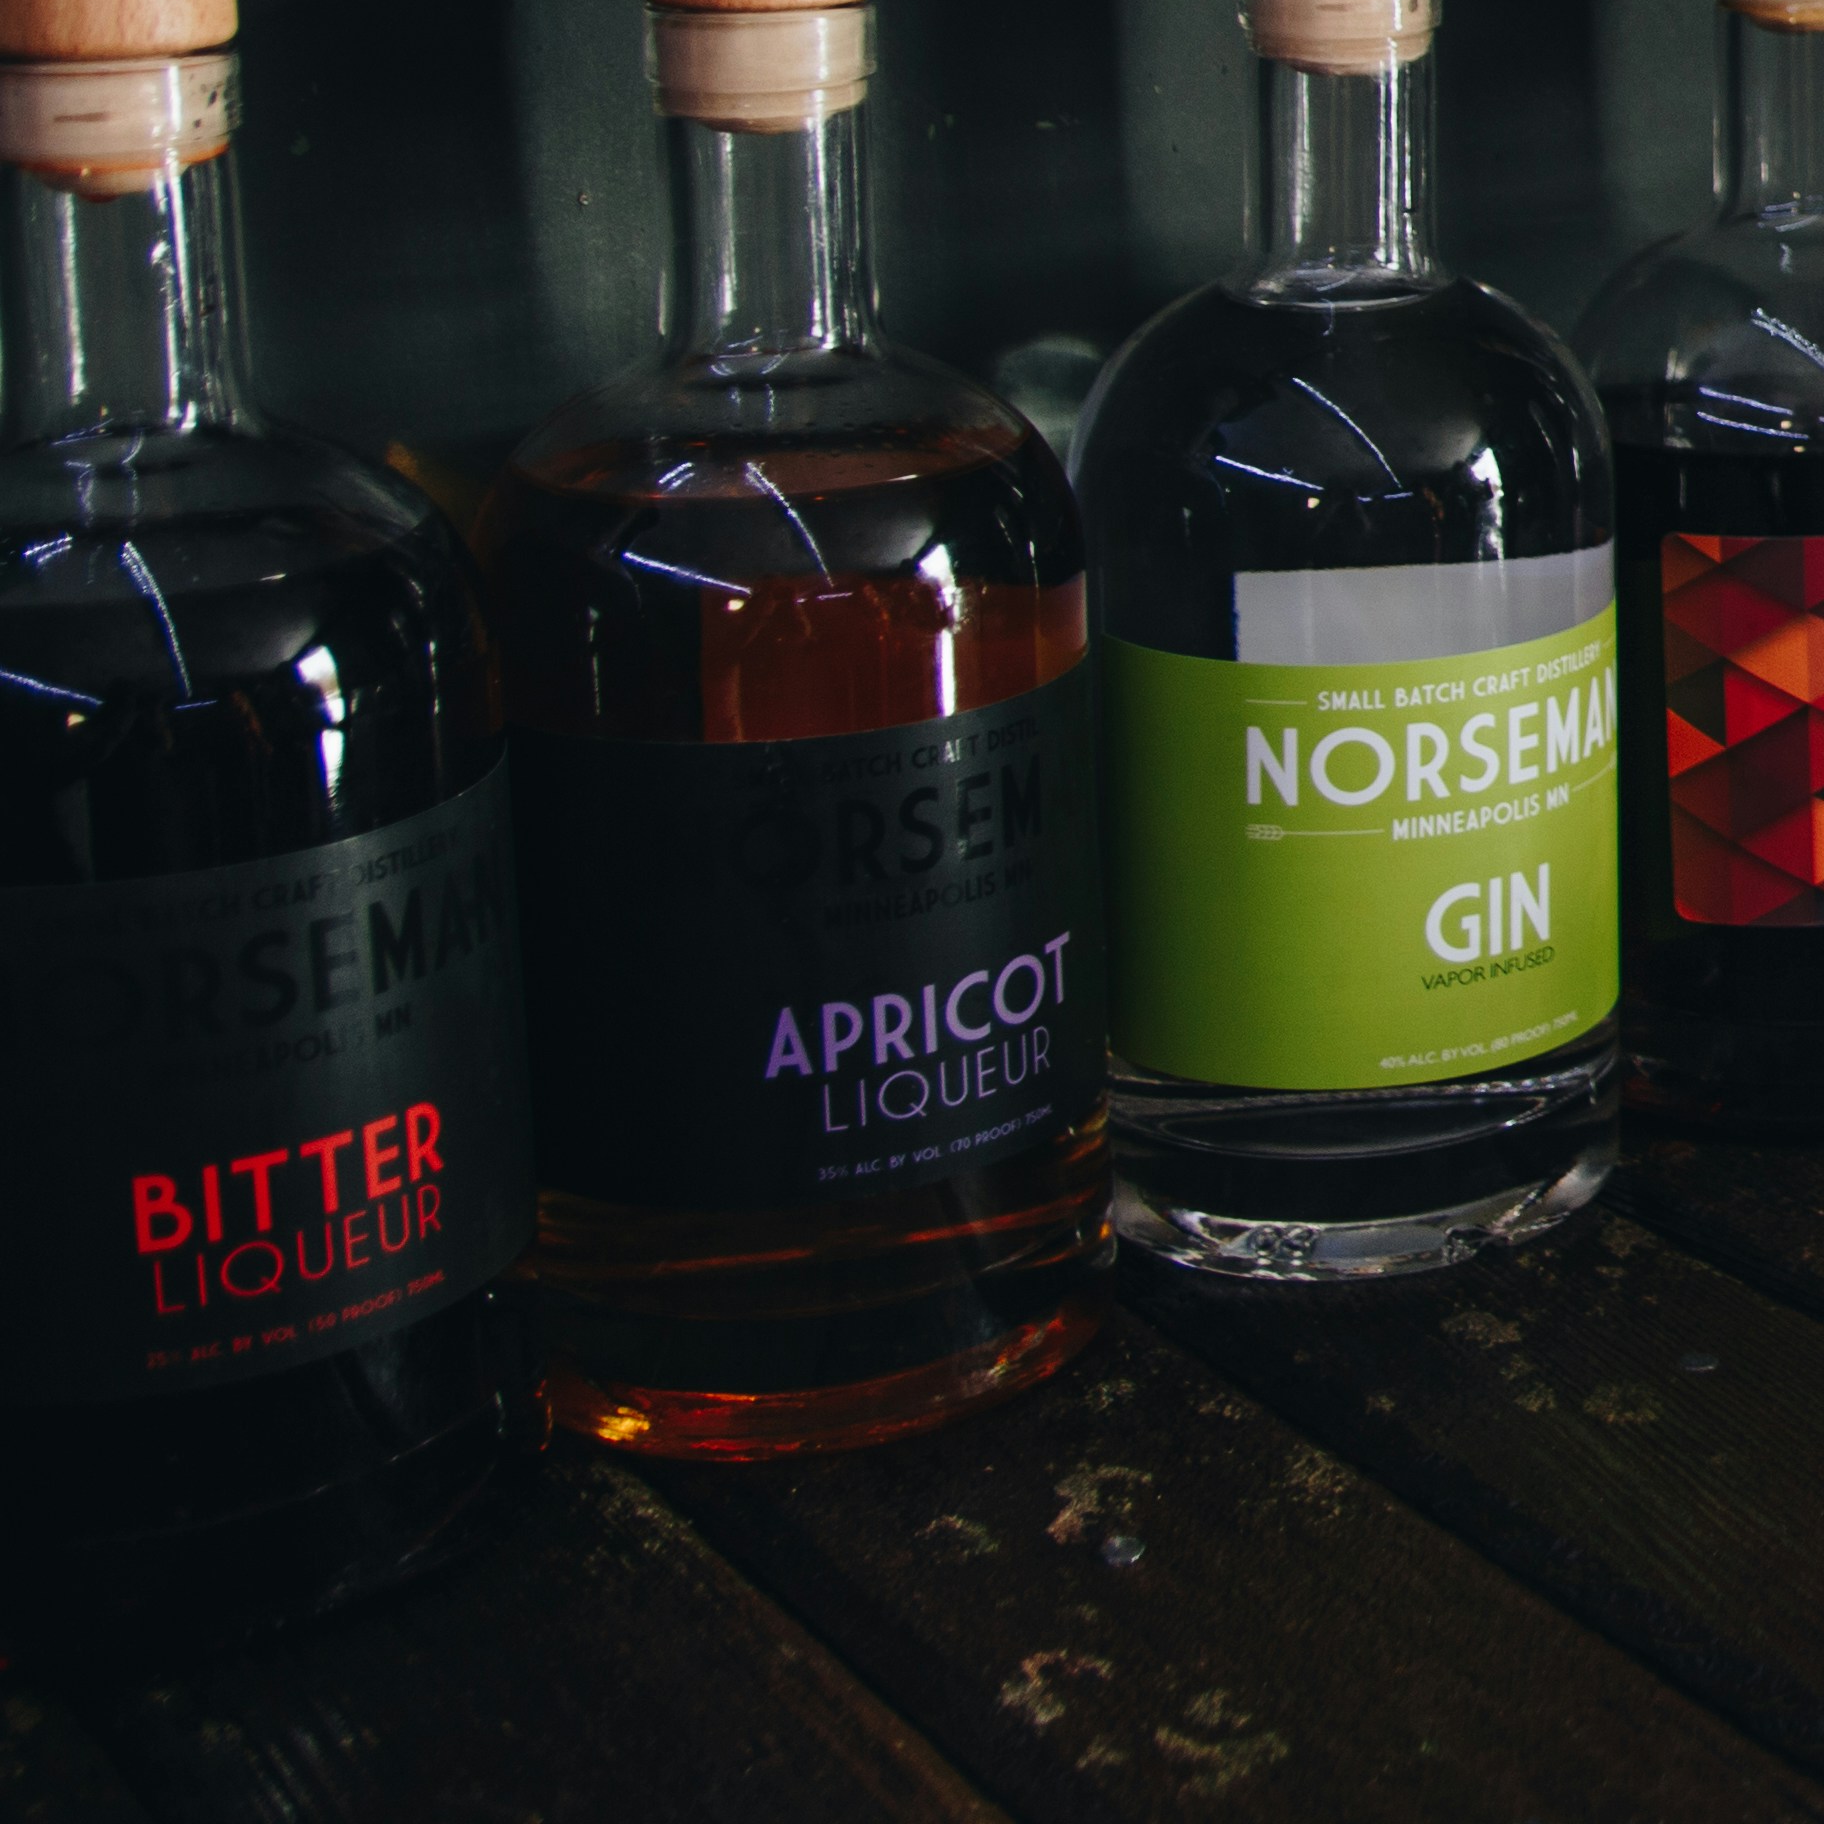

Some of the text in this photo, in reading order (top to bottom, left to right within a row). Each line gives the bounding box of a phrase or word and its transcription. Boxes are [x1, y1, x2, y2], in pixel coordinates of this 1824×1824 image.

[1317, 641, 1601, 711] SMALL BATCH CRAFT DISTILLERY
[1392, 782, 1569, 841] MINNEAPOLIS MN
[824, 871, 997, 930] MINNEAPOLIS
[1425, 862, 1550, 963] GIN
[1421, 945, 1555, 990] VAPOR INFUSED
[374, 1004, 413, 1037] MN
[763, 930, 1072, 1080] APRICOT
[821, 1025, 1052, 1134] LIQUEUR
[1441, 1048, 1457, 1062] BY
[888, 1154, 905, 1169] BY
[974, 1117, 1021, 1146] PROOF)
[130, 1100, 446, 1257] BITTER
[153, 1184, 443, 1316] LIQUEUR
[232, 1335, 253, 1355] BY
[341, 1288, 403, 1323] PROOF)
